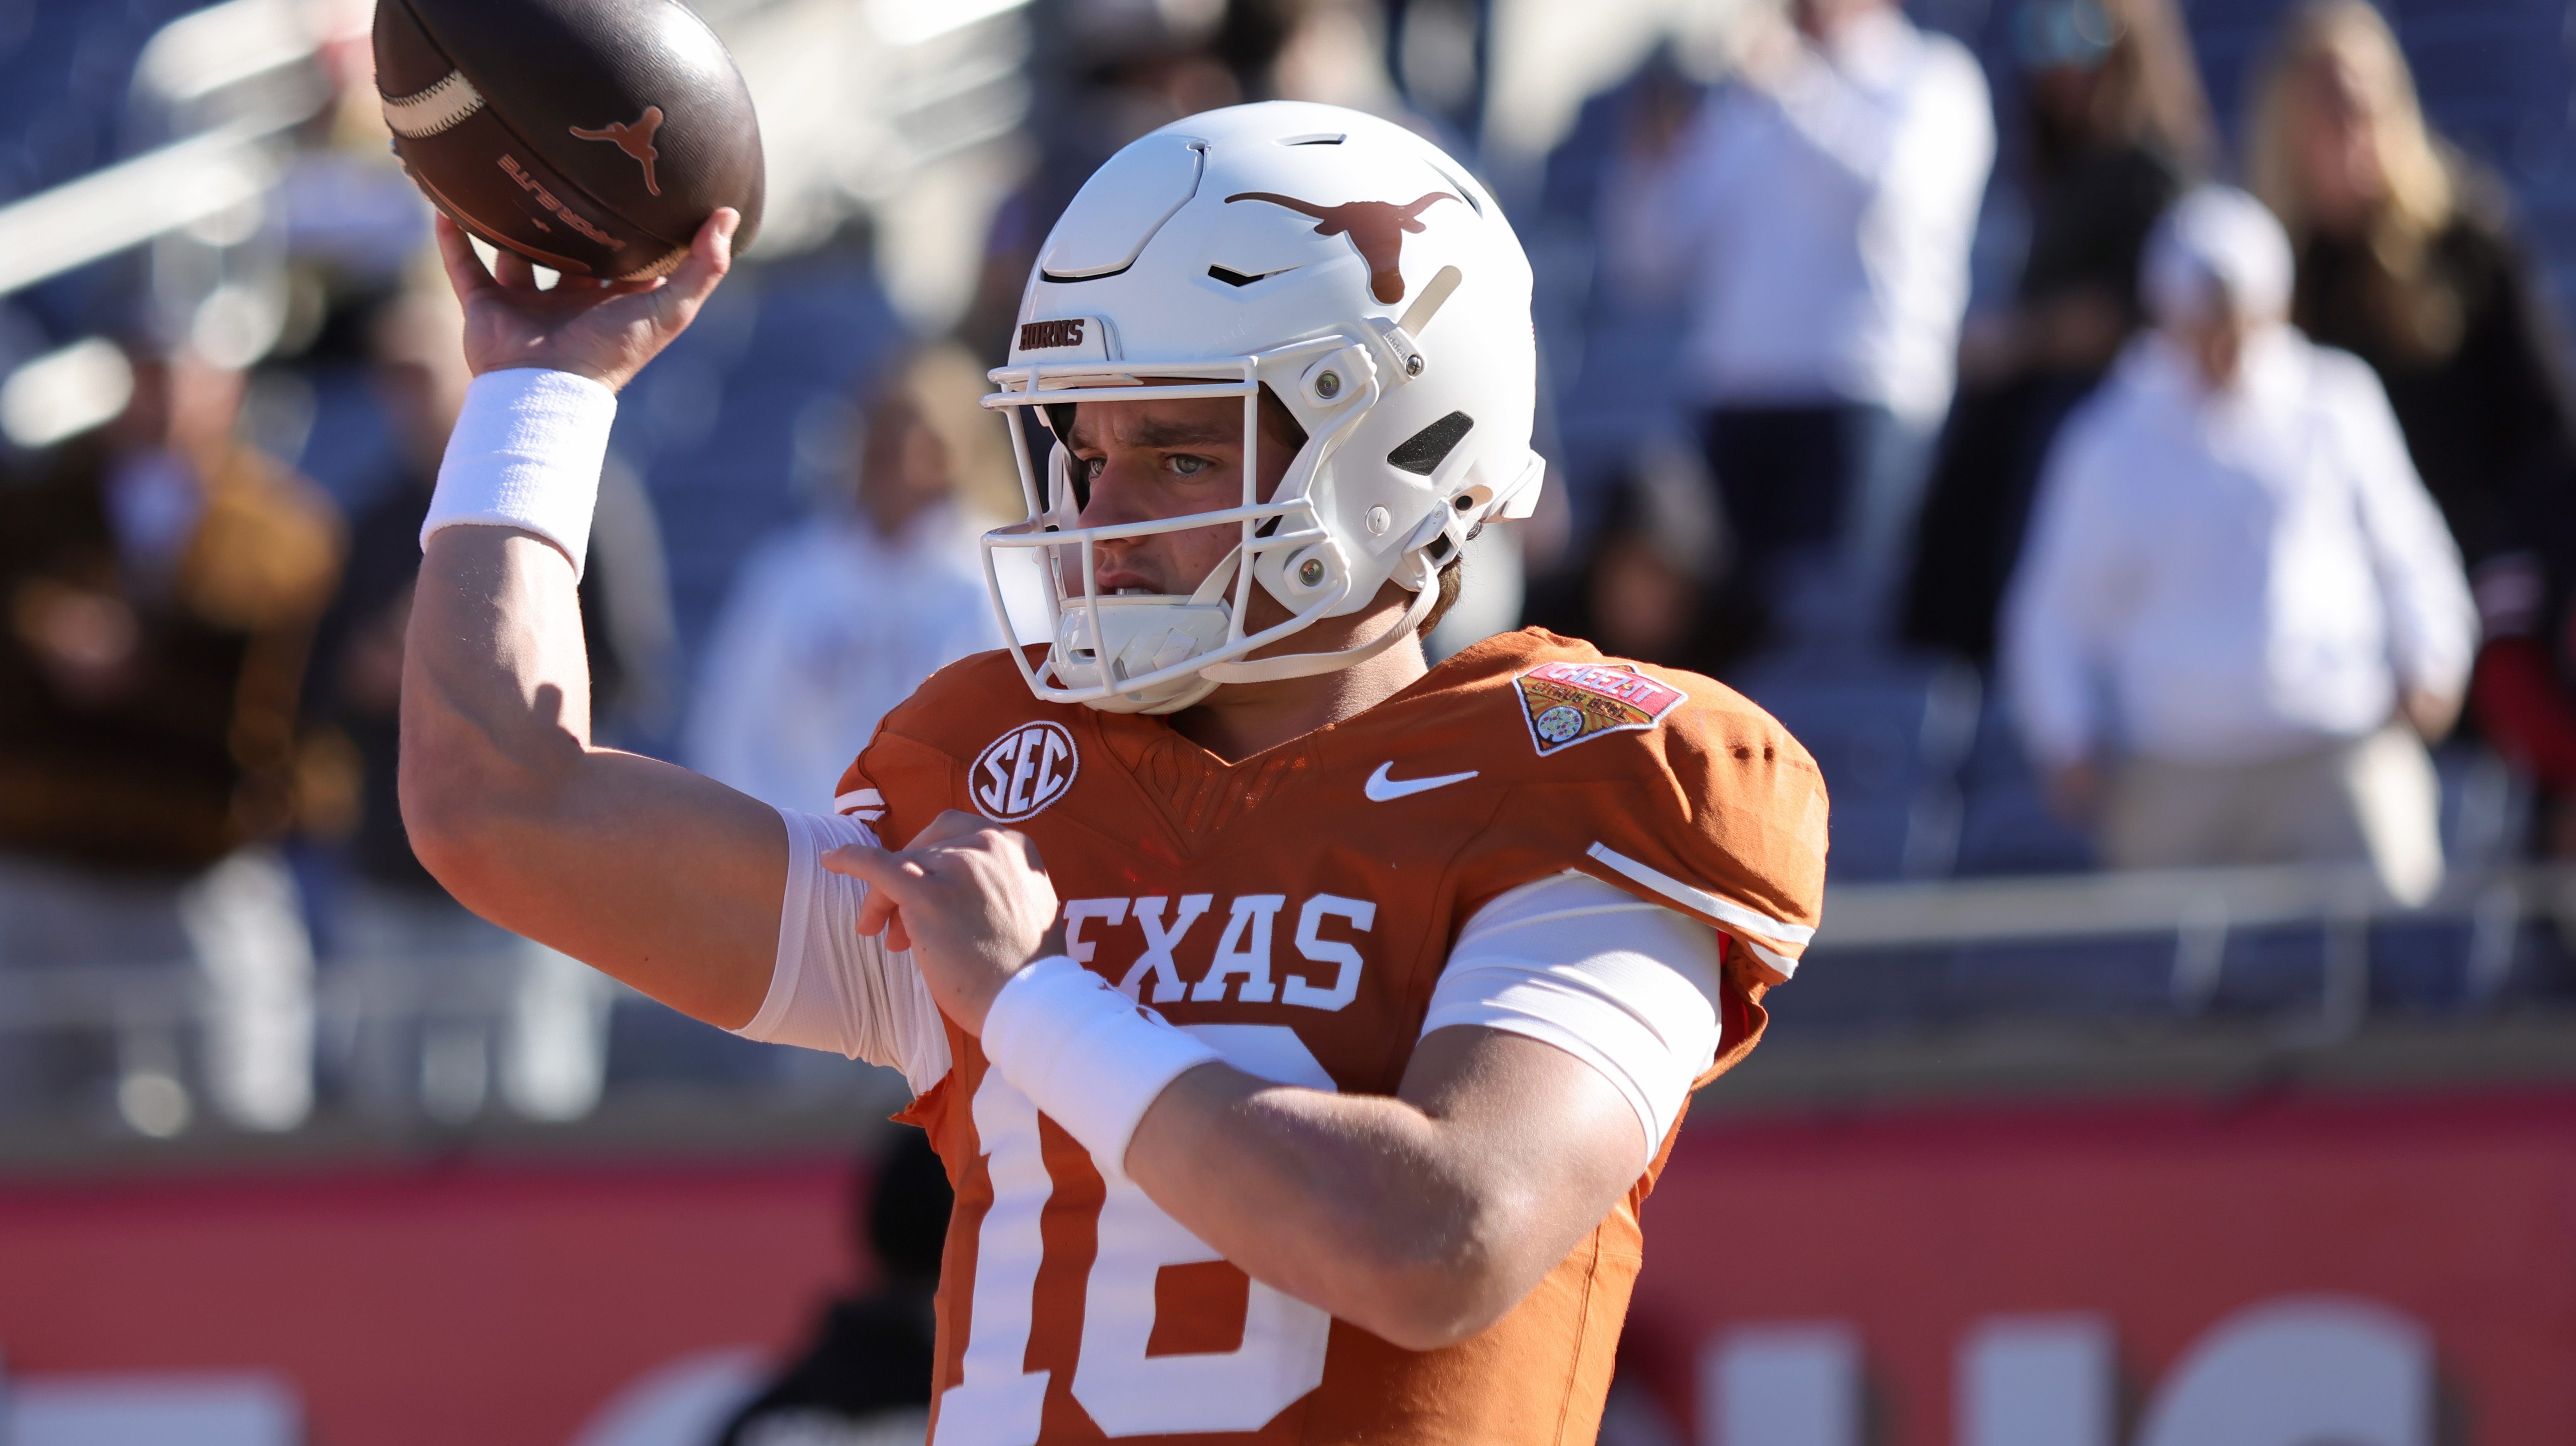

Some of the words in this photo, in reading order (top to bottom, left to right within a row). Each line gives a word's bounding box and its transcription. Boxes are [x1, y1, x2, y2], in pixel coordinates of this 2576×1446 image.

[497, 153, 563, 212] ELITE
[1019, 319, 1085, 351] HORNS
[979, 728, 1068, 814] SEC
[1062, 893, 1377, 1012] EXAS
[932, 1024, 1337, 1446] 16
